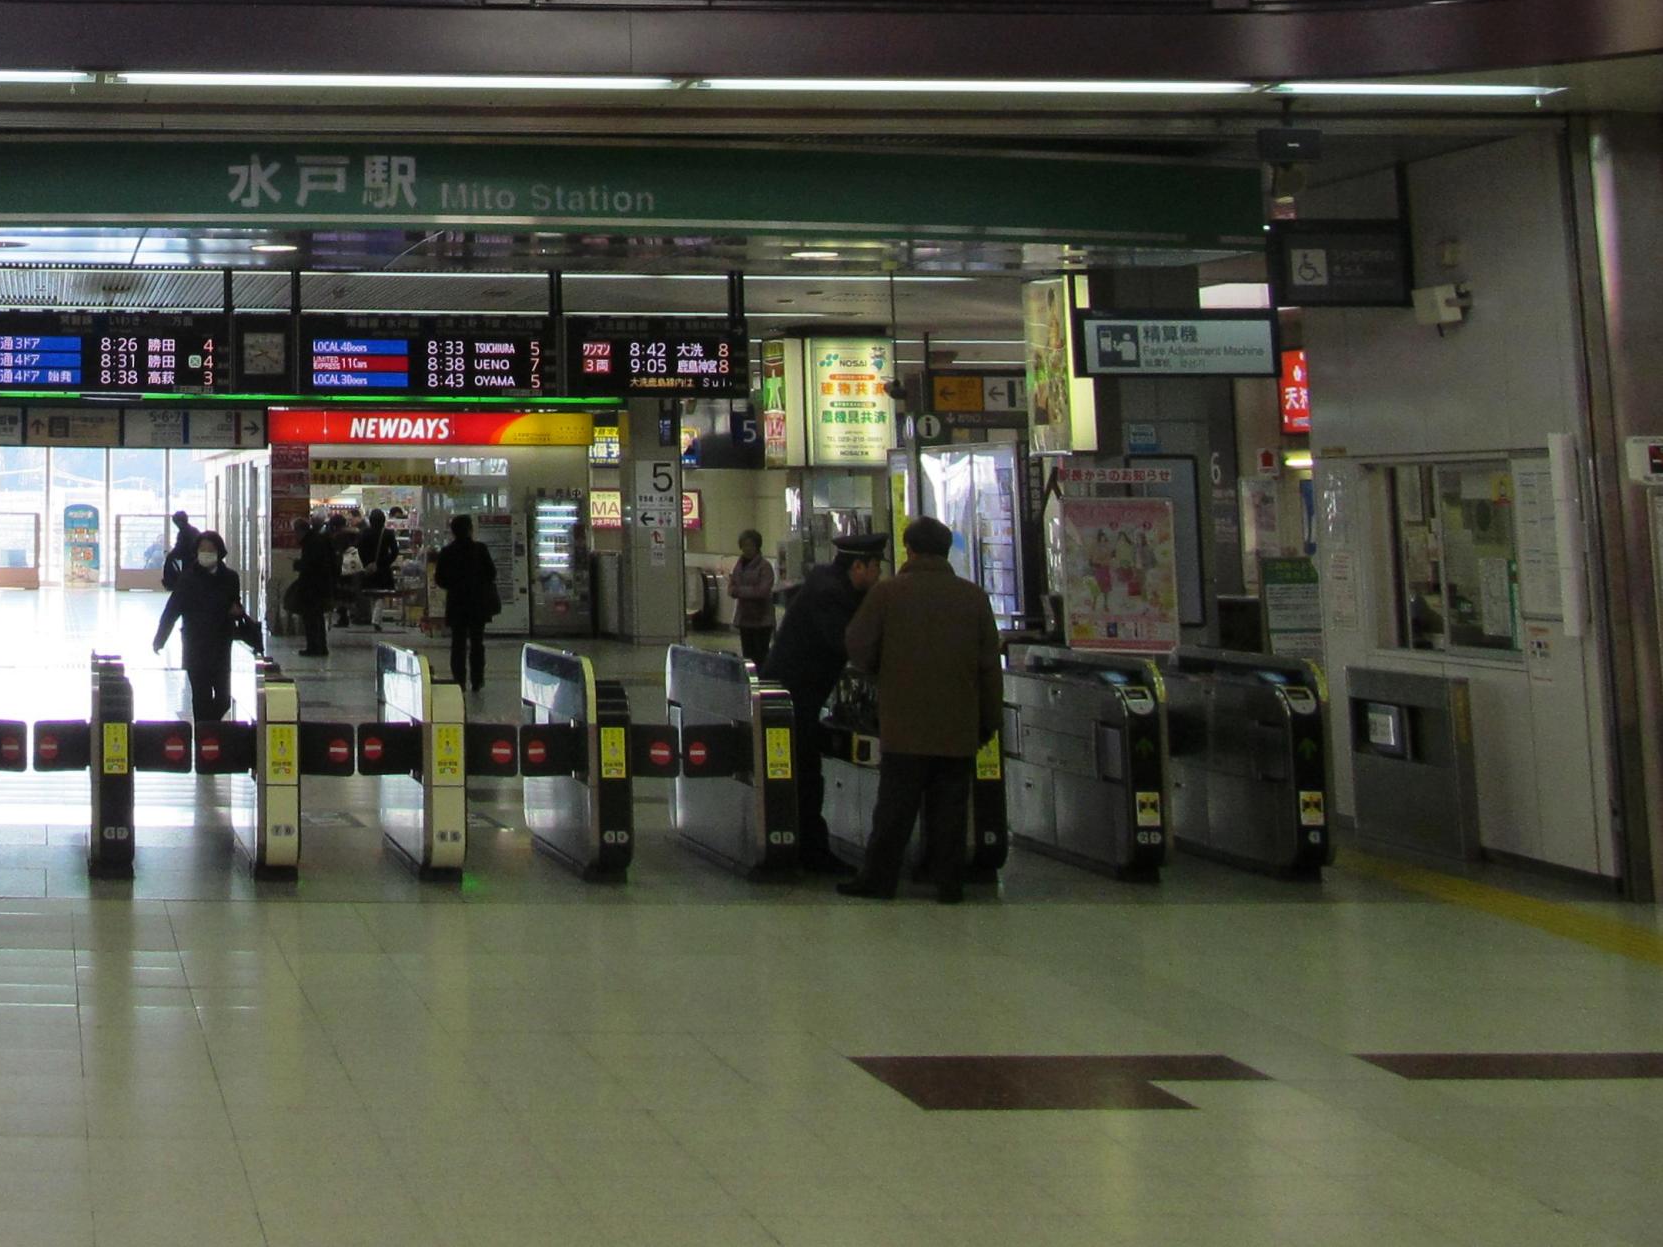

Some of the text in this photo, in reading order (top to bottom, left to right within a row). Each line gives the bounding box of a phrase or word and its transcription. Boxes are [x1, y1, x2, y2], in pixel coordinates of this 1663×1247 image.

[228, 153, 654, 213] 水戸駅 Mito Station
[1143, 325, 1197, 342] 精算機
[101, 338, 137, 351] 8:26
[148, 339, 175, 352] 勝田
[203, 339, 213, 351] 4
[313, 341, 340, 352] LOCAL
[428, 341, 464, 355] 8:33
[475, 343, 515, 354] TSUCHIURA
[531, 342, 540, 355] 5
[583, 343, 729, 357] ワンマン 8:42 大洗 8
[101, 354, 136, 367] 8:31
[148, 355, 175, 368] 勝田
[203, 356, 213, 368] 4
[428, 357, 465, 370] 8:38
[475, 360, 509, 370] UENO
[531, 359, 539, 370] 7
[630, 360, 666, 373] 9:05
[677, 360, 718, 373] 鹿島神宮
[719, 360, 729, 373] 8
[48, 371, 72, 383] 始発
[101, 371, 137, 384] 8:38
[148, 372, 175, 384] 高萩
[203, 372, 213, 384] 3
[313, 374, 540, 388] LOCAL 8:43 OYAMA 5
[350, 417, 449, 439] NEWDAYS
[743, 420, 756, 442] 5
[1211, 452, 1221, 482] 6
[653, 463, 672, 492] 5
